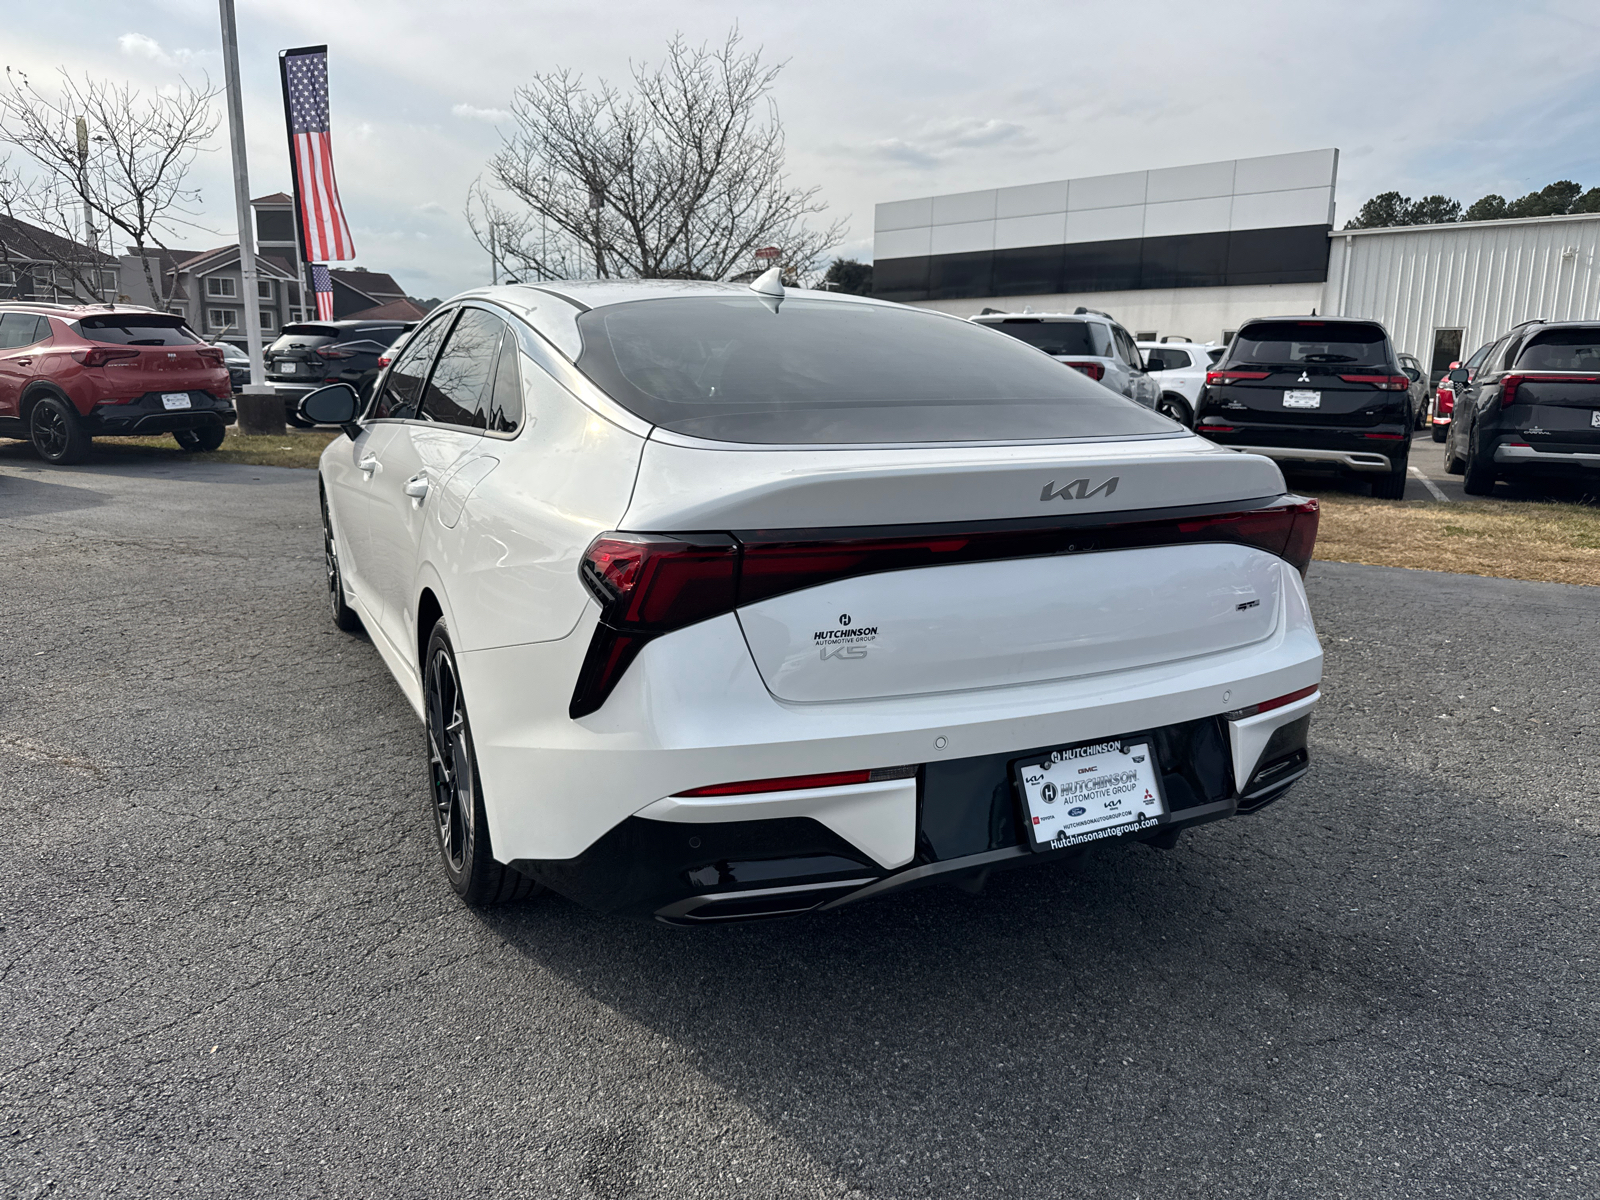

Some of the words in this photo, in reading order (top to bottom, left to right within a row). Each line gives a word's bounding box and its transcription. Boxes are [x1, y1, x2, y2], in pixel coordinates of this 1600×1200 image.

[1040, 476, 1120, 501] KIA
[814, 626, 878, 640] HUTCHINSON
[815, 637, 854, 646] AUTOMOTIVE
[855, 635, 876, 643] GROUP
[820, 645, 868, 661] K5
[1063, 741, 1121, 761] HUTCHINSON
[1077, 765, 1098, 775] GMC
[1060, 769, 1138, 797] HUTCHINSON
[1063, 789, 1111, 806] AUTOMOTIVE
[1112, 783, 1137, 795] GROUP
[1063, 810, 1133, 830] HUTCHINSONAUTOGROUP.COM
[1069, 807, 1084, 817] Ford
[1050, 817, 1159, 850] Hutchinsonautogroup.com
